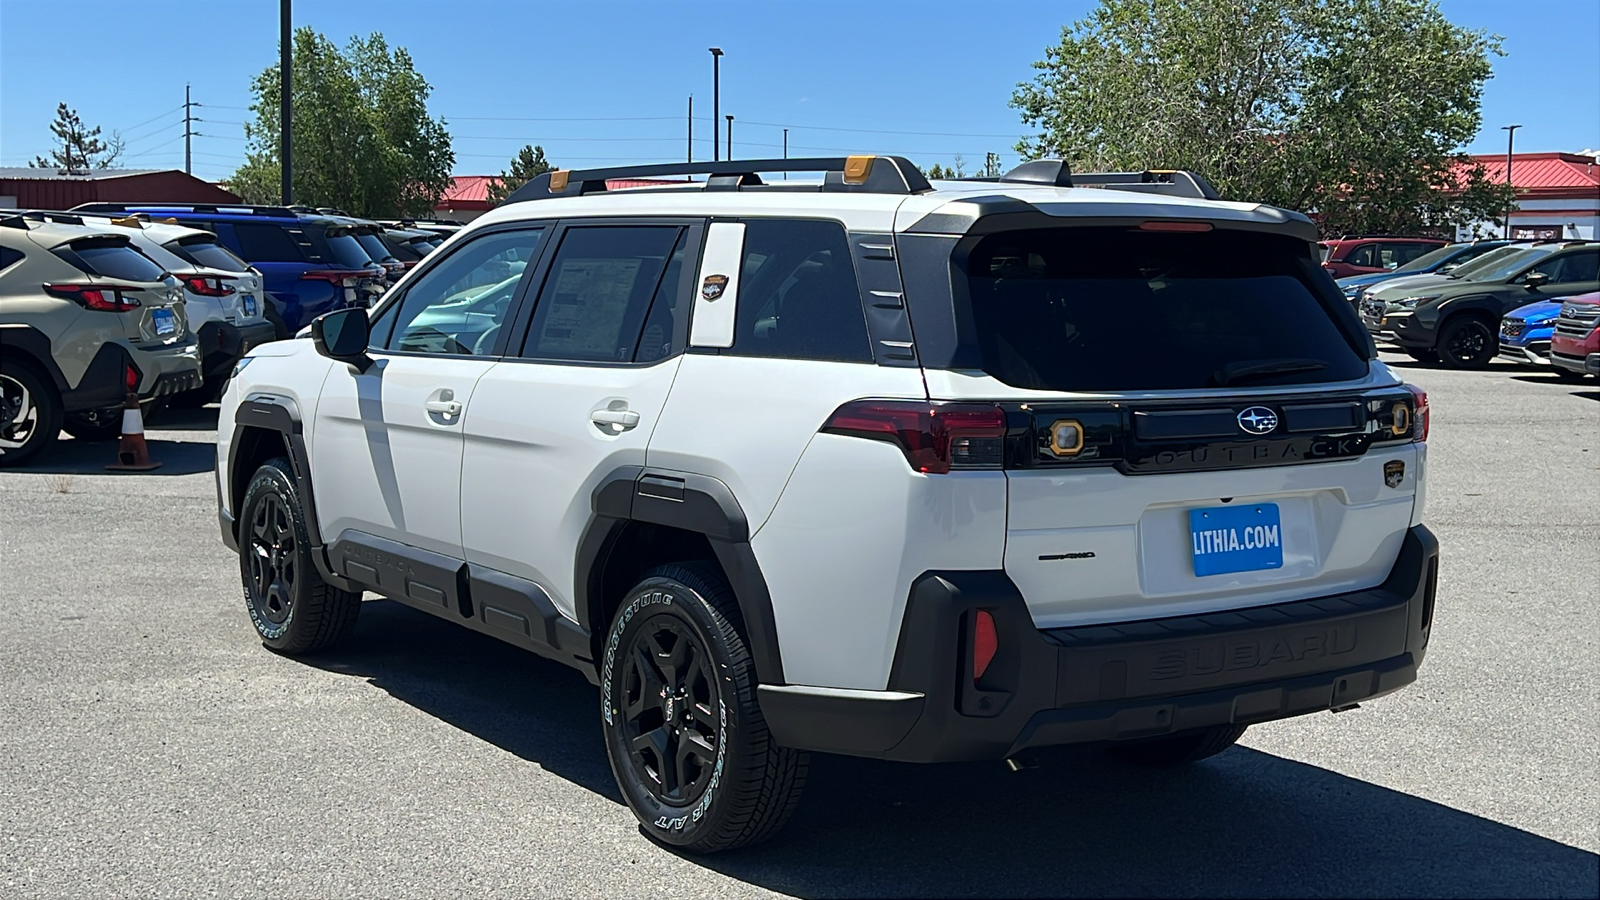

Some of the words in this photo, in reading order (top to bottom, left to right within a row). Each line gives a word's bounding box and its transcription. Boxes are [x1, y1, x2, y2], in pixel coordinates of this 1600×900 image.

[1155, 439, 1351, 465] OUTBACK
[1193, 524, 1279, 555] LITHIA.COM
[343, 544, 416, 576] OUTBACK
[603, 592, 674, 726] BRIDGESTONE
[1150, 624, 1359, 681] SUBARU
